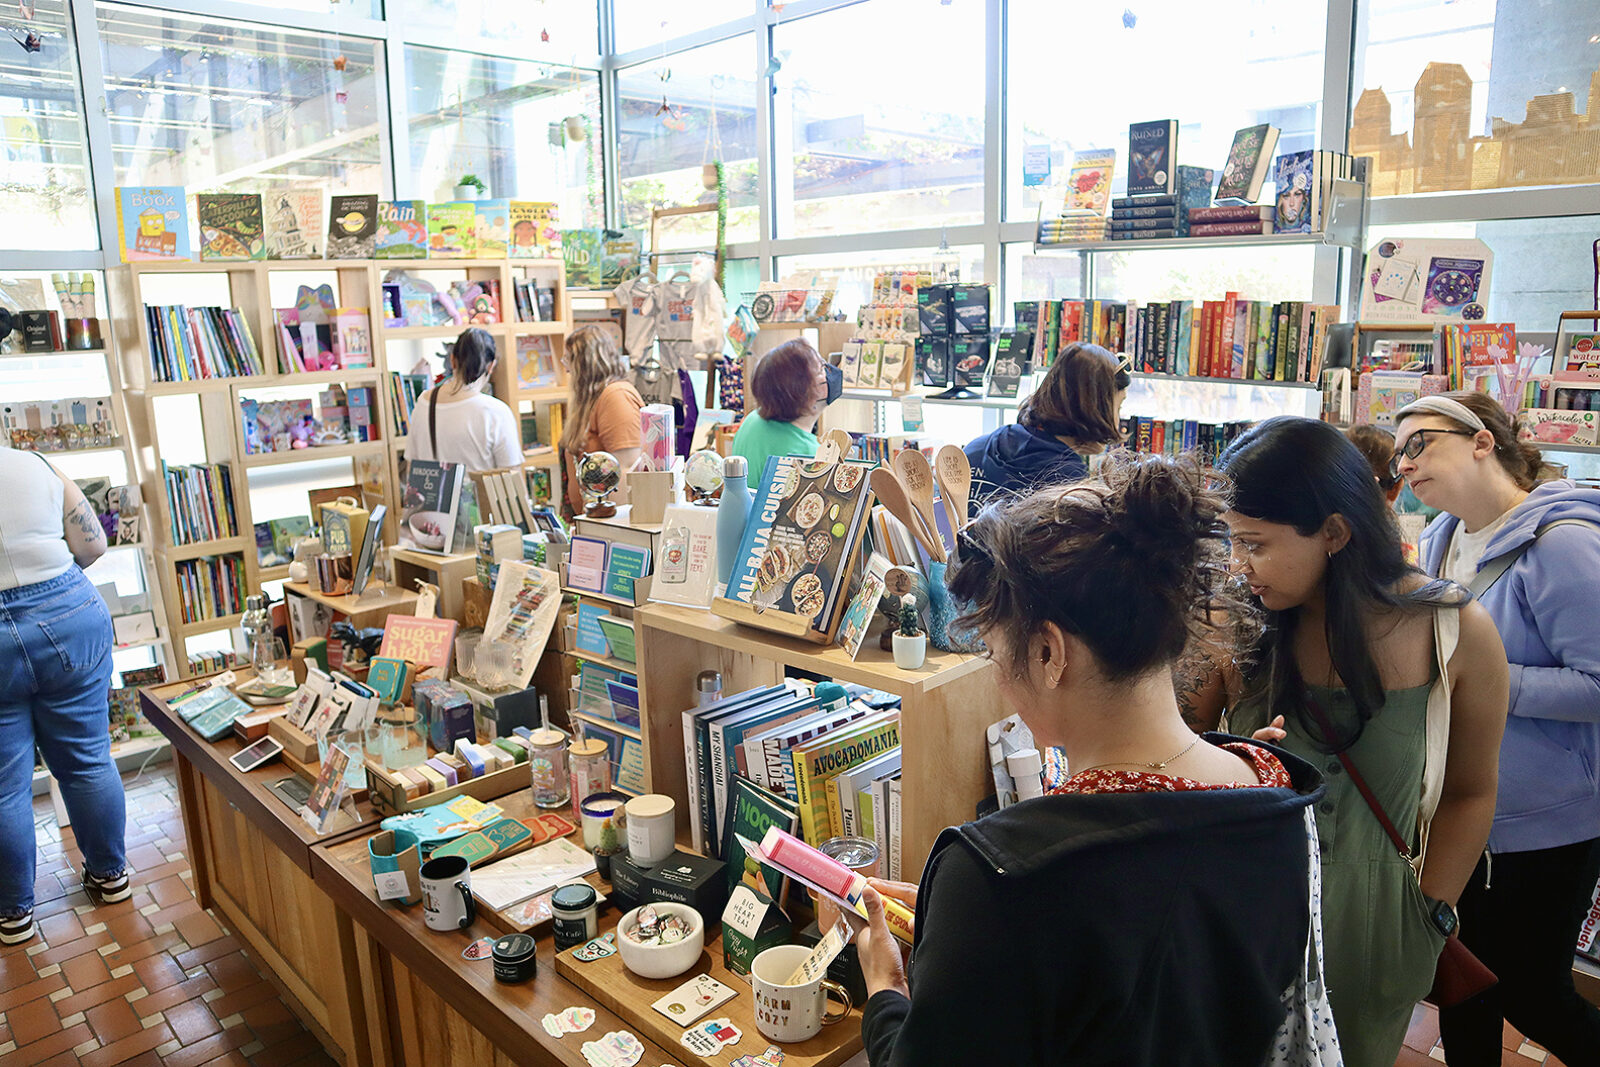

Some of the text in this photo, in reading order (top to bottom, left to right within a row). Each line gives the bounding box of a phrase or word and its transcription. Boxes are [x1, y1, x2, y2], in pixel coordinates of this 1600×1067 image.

[378, 202, 415, 221] Rain
[1461, 334, 1485, 346] PAPER
[330, 530, 345, 543] PUB
[736, 527, 772, 604] ALI-BAJA
[761, 456, 794, 523] CUISINE
[389, 626, 449, 648] sugar
[386, 641, 431, 663] high
[712, 731, 723, 786] MY SHANGHAI
[813, 728, 899, 777] AVOCADOMANIA
[764, 739, 785, 792] MADE
[652, 887, 686, 902] Bibliophile
[742, 898, 754, 910] BIG
[734, 903, 755, 921] HEART
[734, 915, 749, 928] TEAS
[1577, 884, 1600, 948] spirogra
[758, 1009, 789, 1028] COZY
